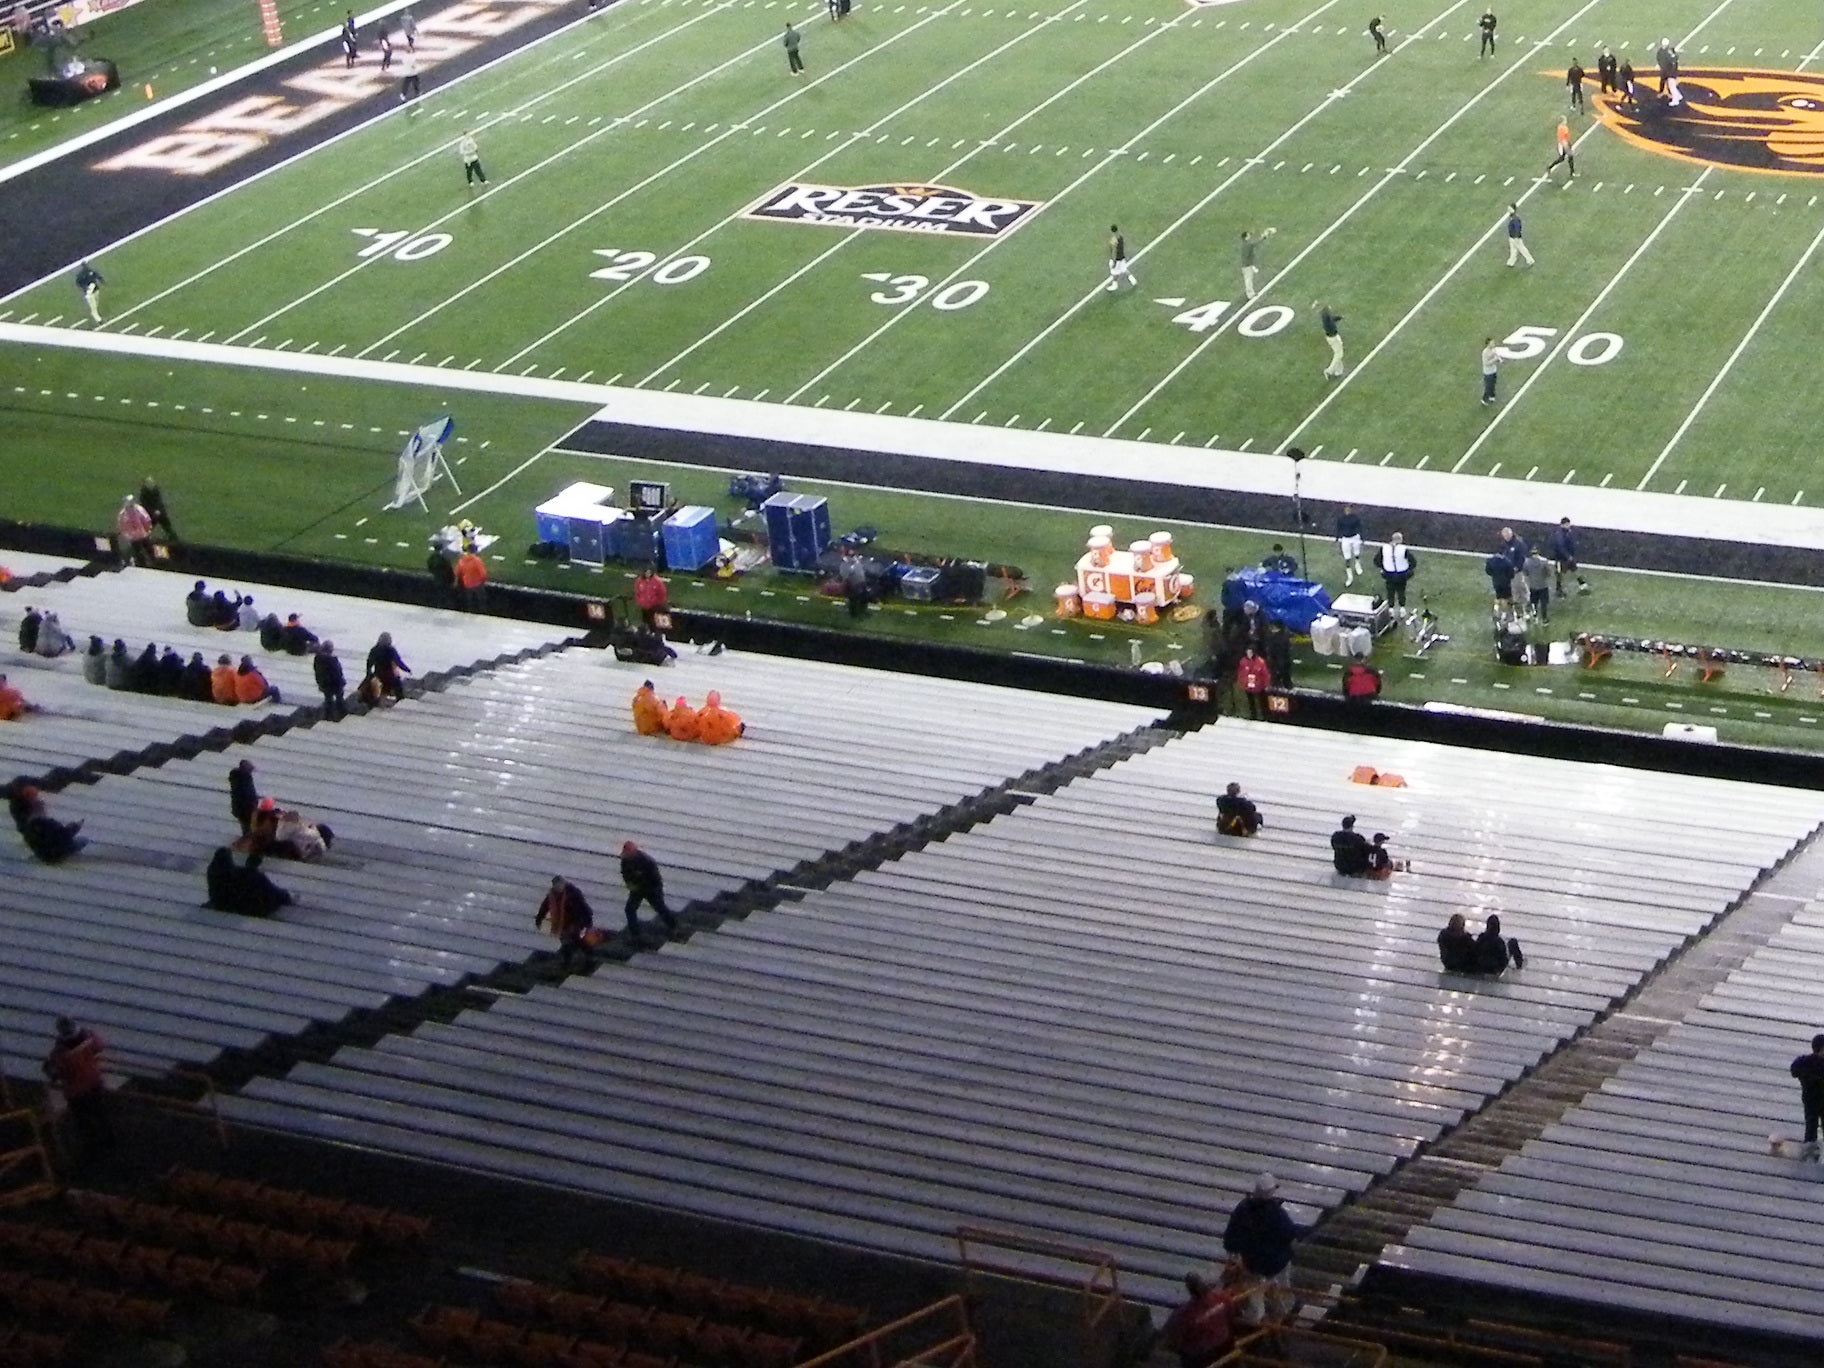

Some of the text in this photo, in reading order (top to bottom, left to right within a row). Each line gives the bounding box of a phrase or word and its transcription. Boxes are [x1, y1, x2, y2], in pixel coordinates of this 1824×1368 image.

[764, 186, 1020, 229] RESER
[356, 229, 452, 261] 10
[589, 251, 711, 284] 20
[872, 274, 990, 310] 30
[1171, 301, 1295, 338] 40
[1497, 325, 1625, 366] 50
[1368, 852, 1377, 868] 4
